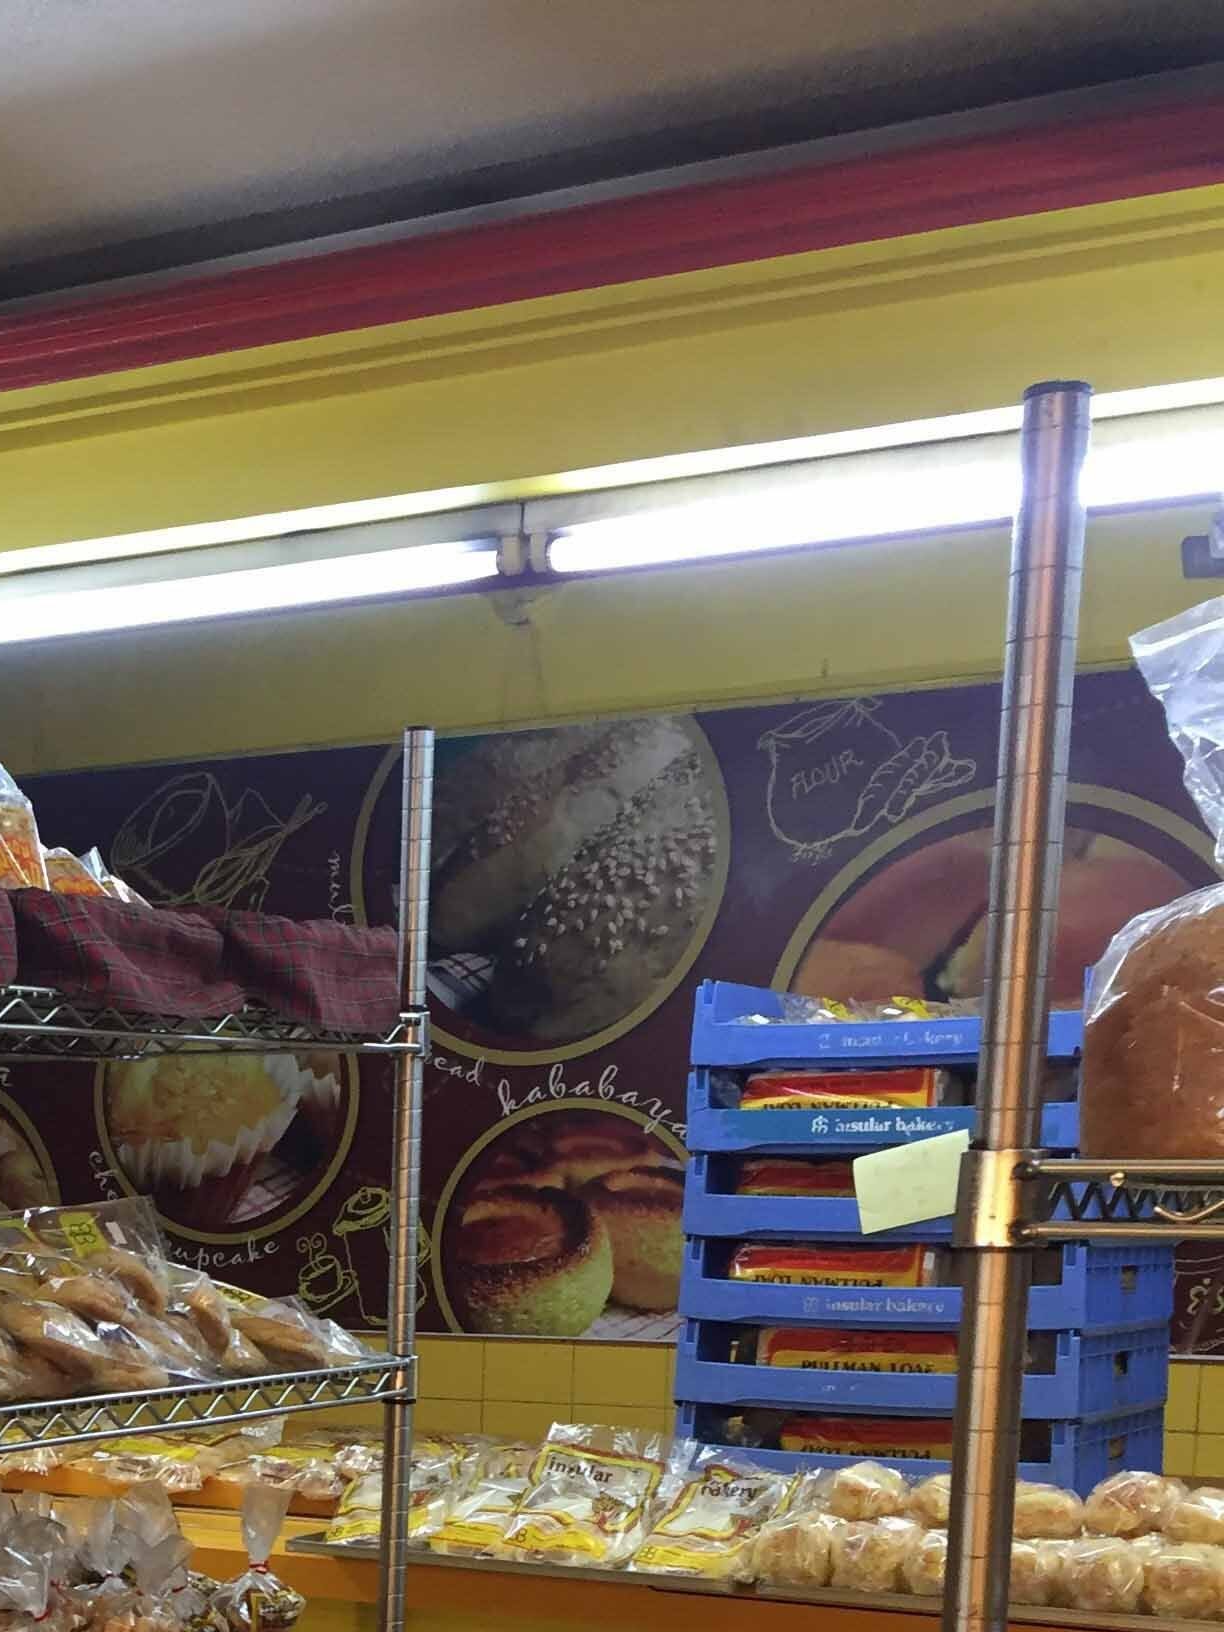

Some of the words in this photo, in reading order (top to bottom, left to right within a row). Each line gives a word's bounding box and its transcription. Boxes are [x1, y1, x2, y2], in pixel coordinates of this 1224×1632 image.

[790, 749, 865, 800] FLOUR
[497, 1062, 688, 1140] kababaya
[175, 1235, 281, 1273] upcake
[549, 1457, 614, 1484] insular
